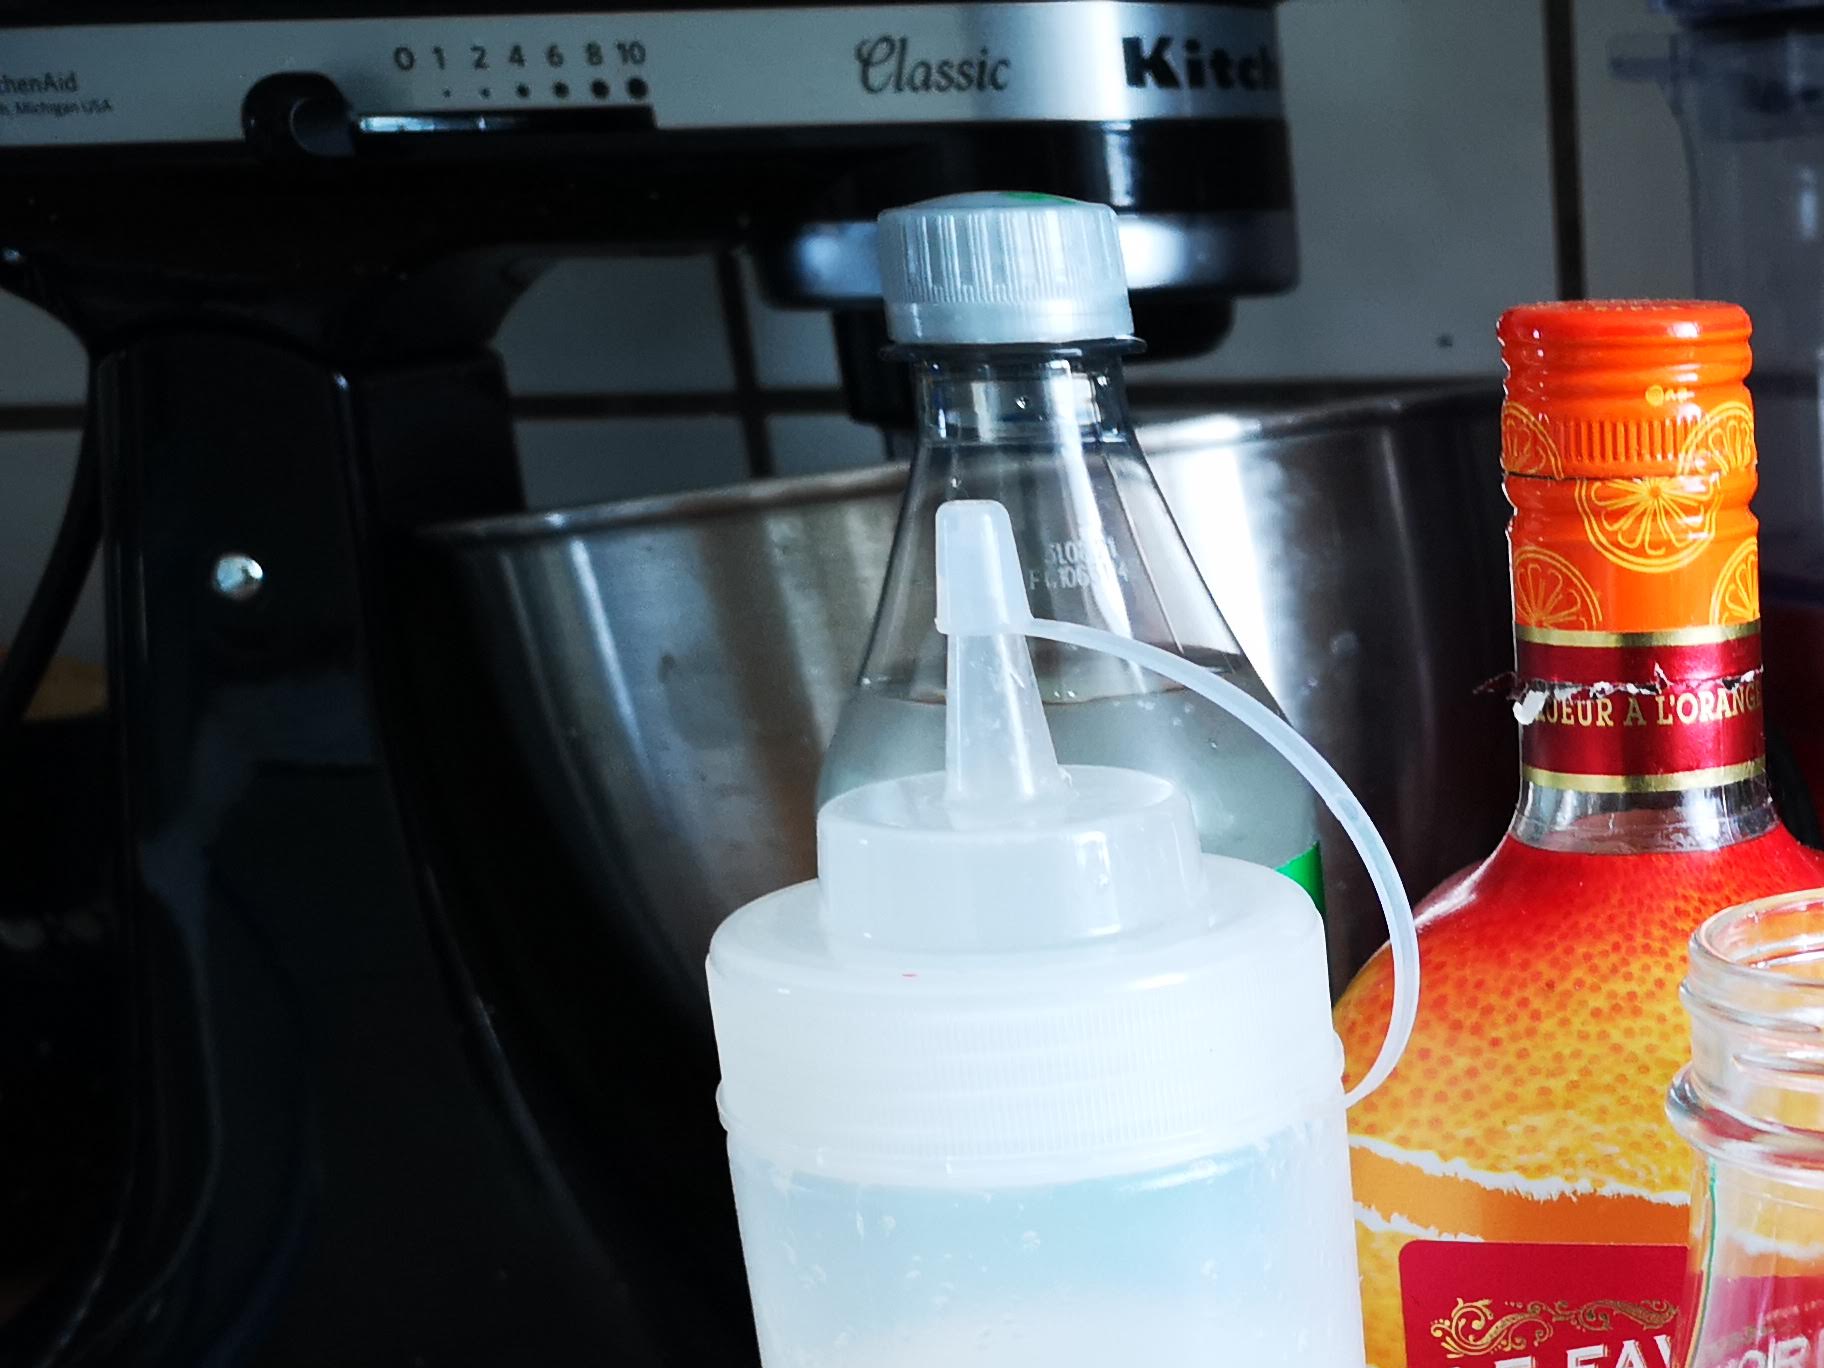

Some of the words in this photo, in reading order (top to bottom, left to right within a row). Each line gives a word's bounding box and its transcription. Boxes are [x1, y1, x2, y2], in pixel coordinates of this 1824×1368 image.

[394, 47, 415, 71] 0
[432, 46, 446, 70] 1
[470, 45, 489, 70] 2
[508, 45, 526, 68] 4
[546, 45, 564, 68] 6
[585, 41, 603, 66] 8
[616, 41, 646, 65] 10
[855, 35, 1011, 94] Classic
